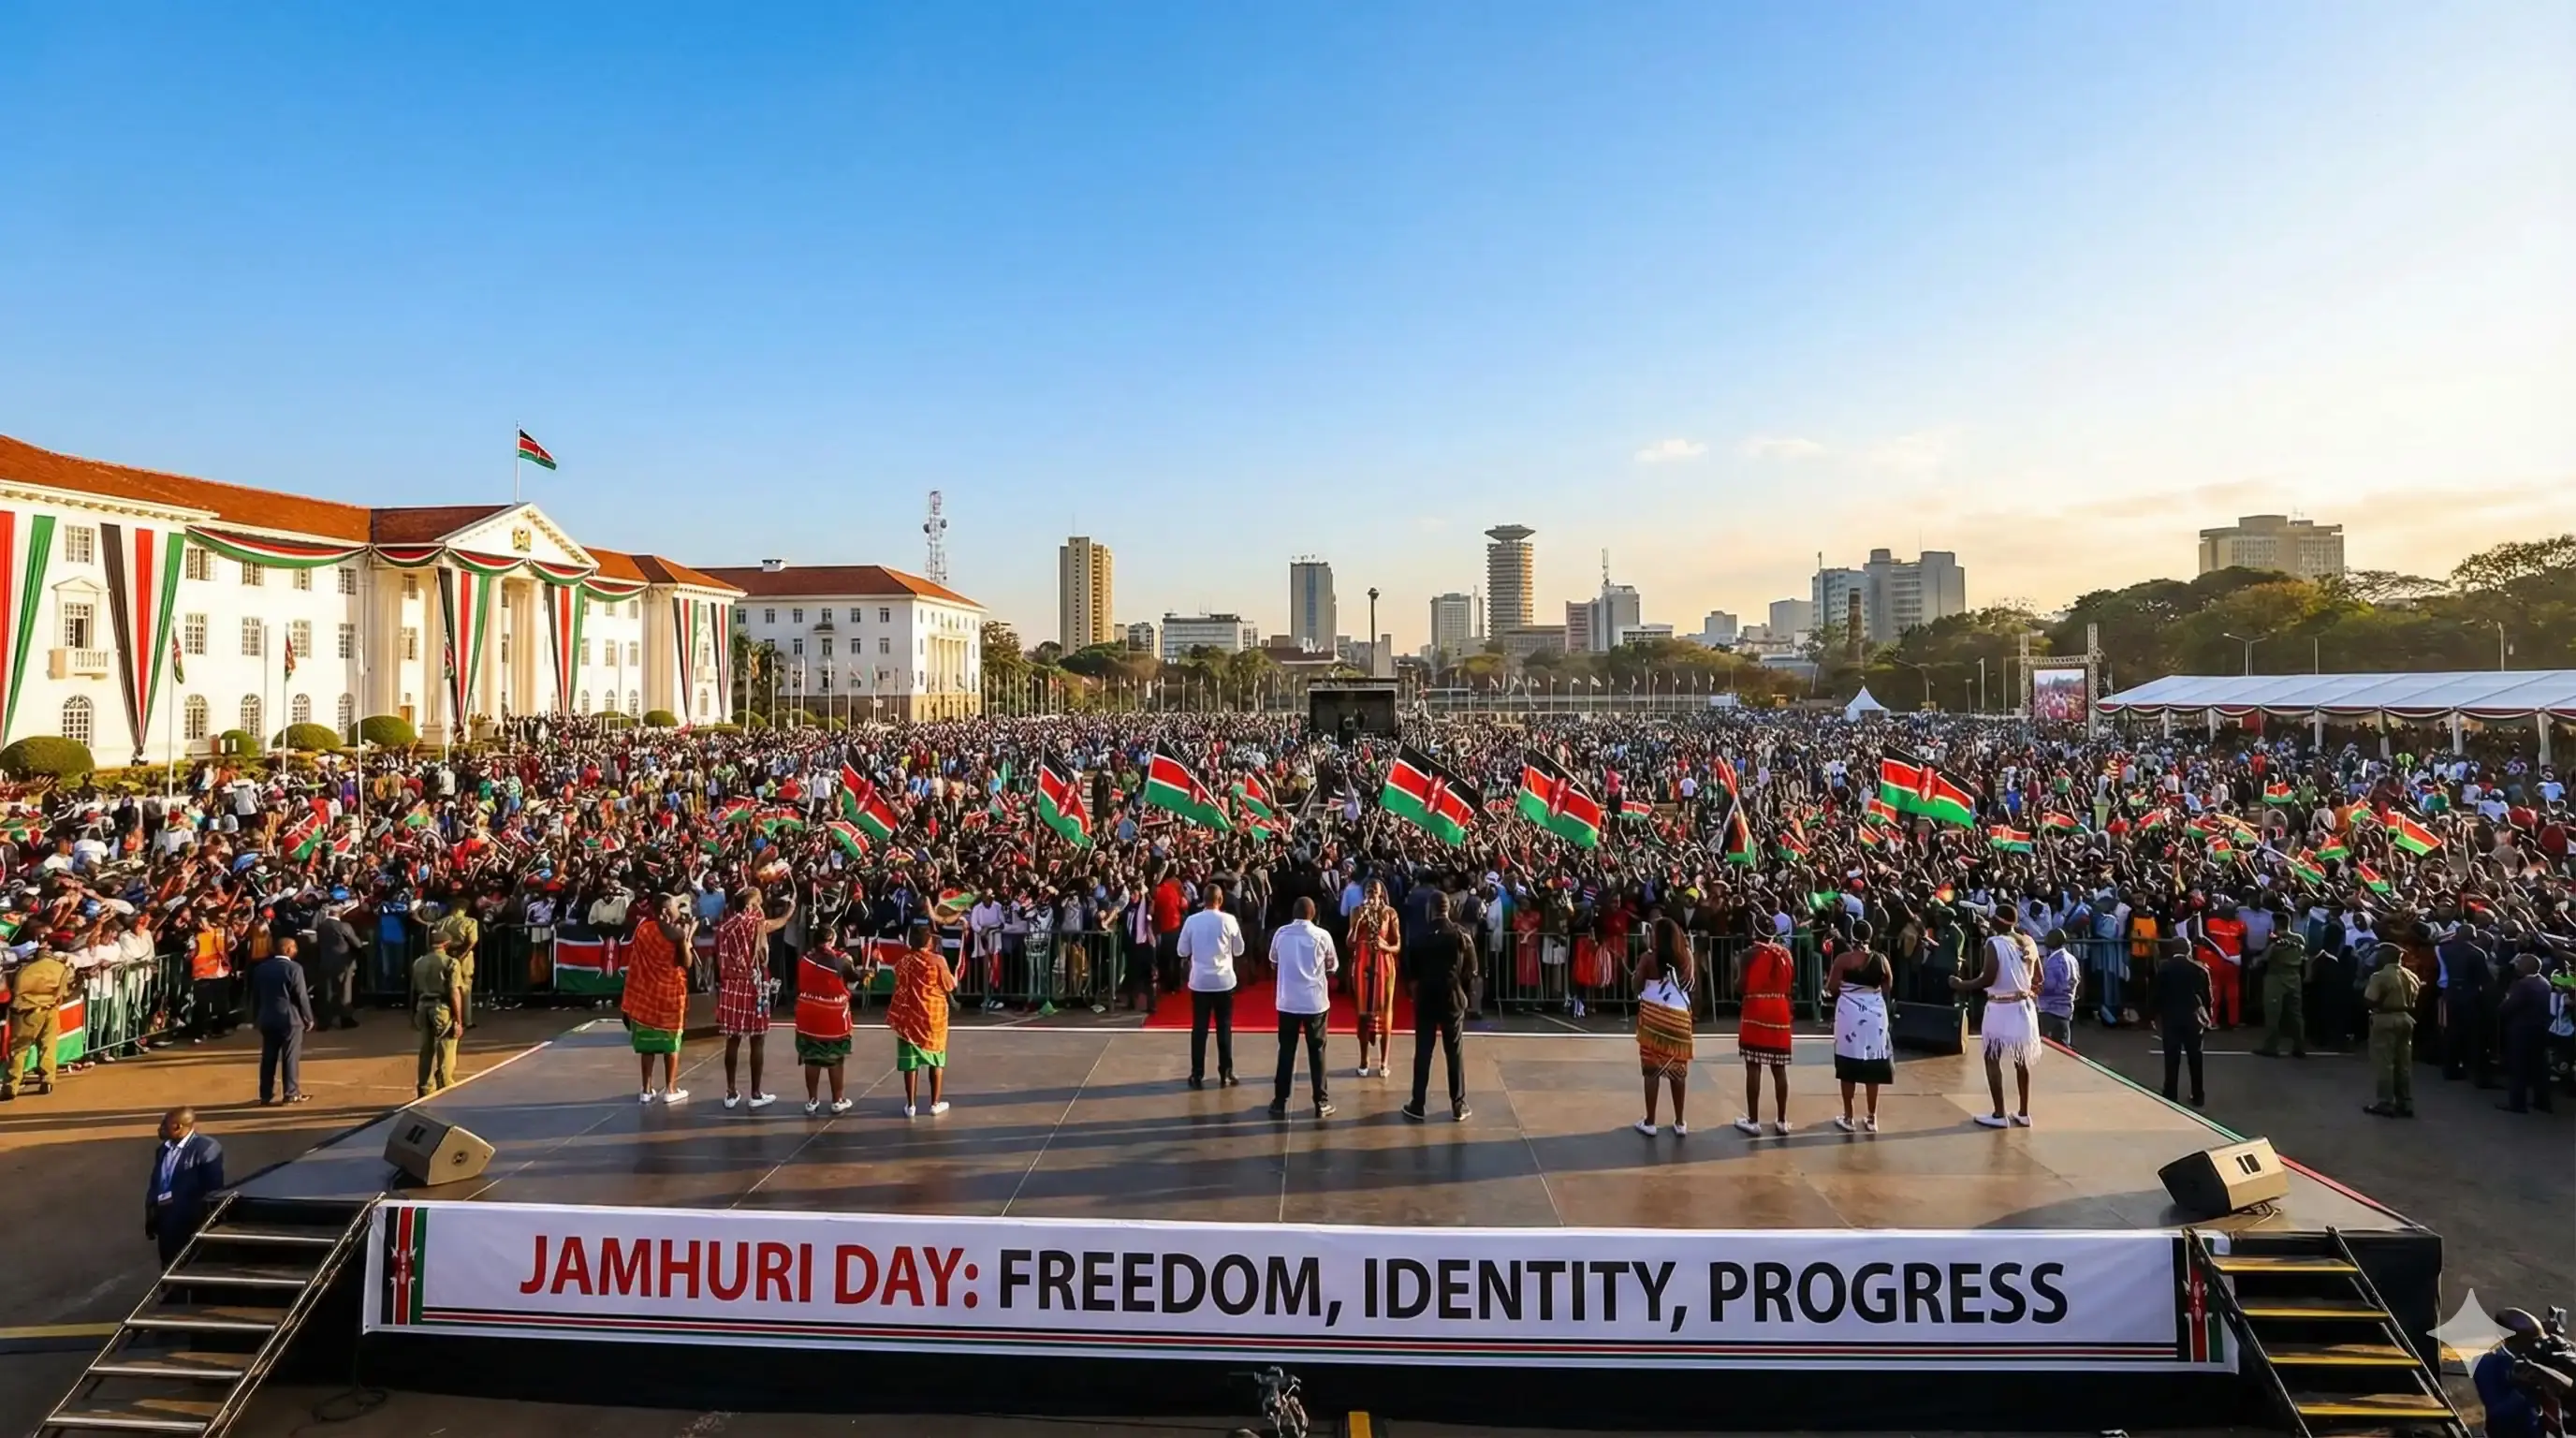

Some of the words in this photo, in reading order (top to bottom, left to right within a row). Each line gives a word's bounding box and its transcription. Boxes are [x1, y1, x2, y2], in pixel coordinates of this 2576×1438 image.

[519, 1235, 812, 1304] JAMHURI
[834, 1244, 979, 1311] DAY:
[1000, 1249, 1342, 1328] FREEDOM,
[1364, 1257, 1688, 1333] IDENTITY,
[1709, 1261, 2069, 1325] PROGRESS
